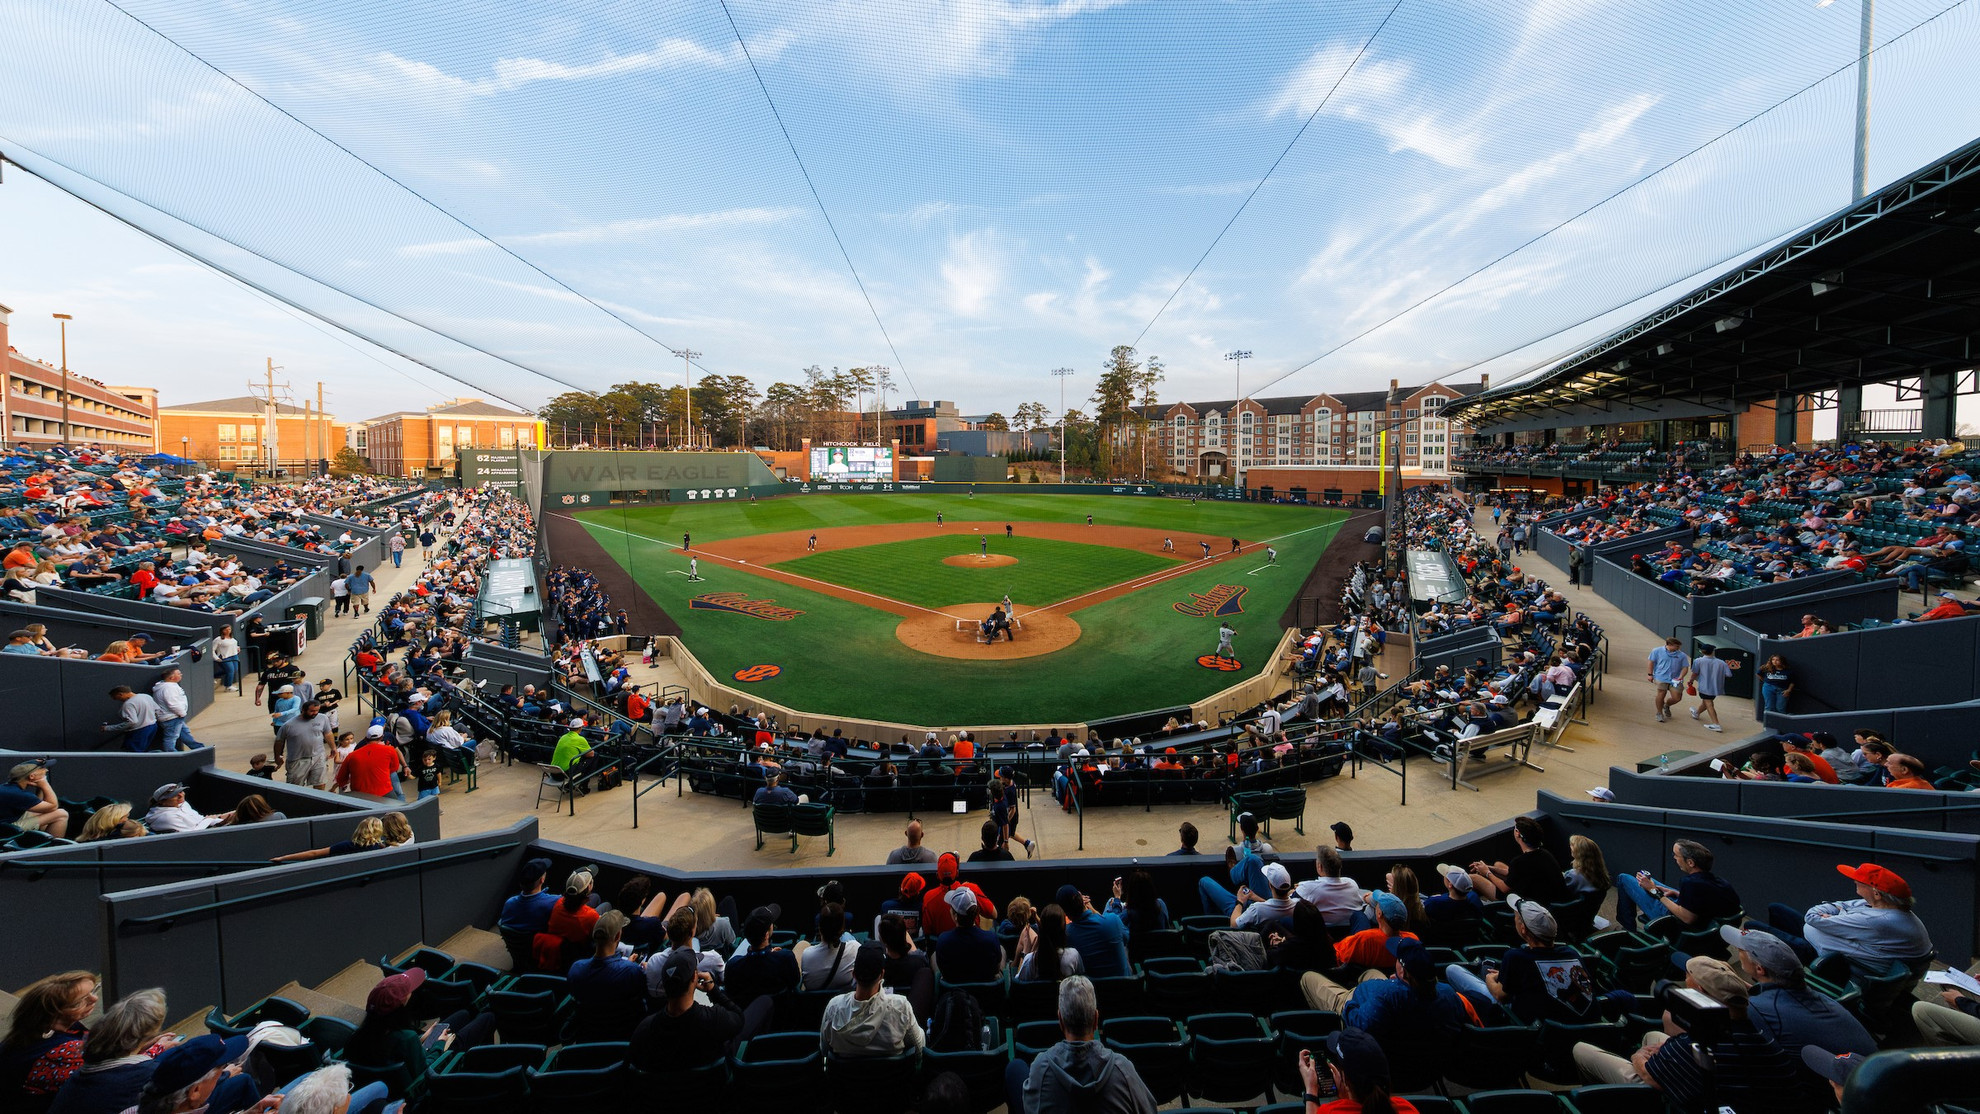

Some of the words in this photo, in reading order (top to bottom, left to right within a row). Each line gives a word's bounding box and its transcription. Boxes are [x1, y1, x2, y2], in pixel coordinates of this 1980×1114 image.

[476, 454, 490, 462] 62
[566, 465, 637, 482] WAR
[647, 465, 729, 480] EAGLE
